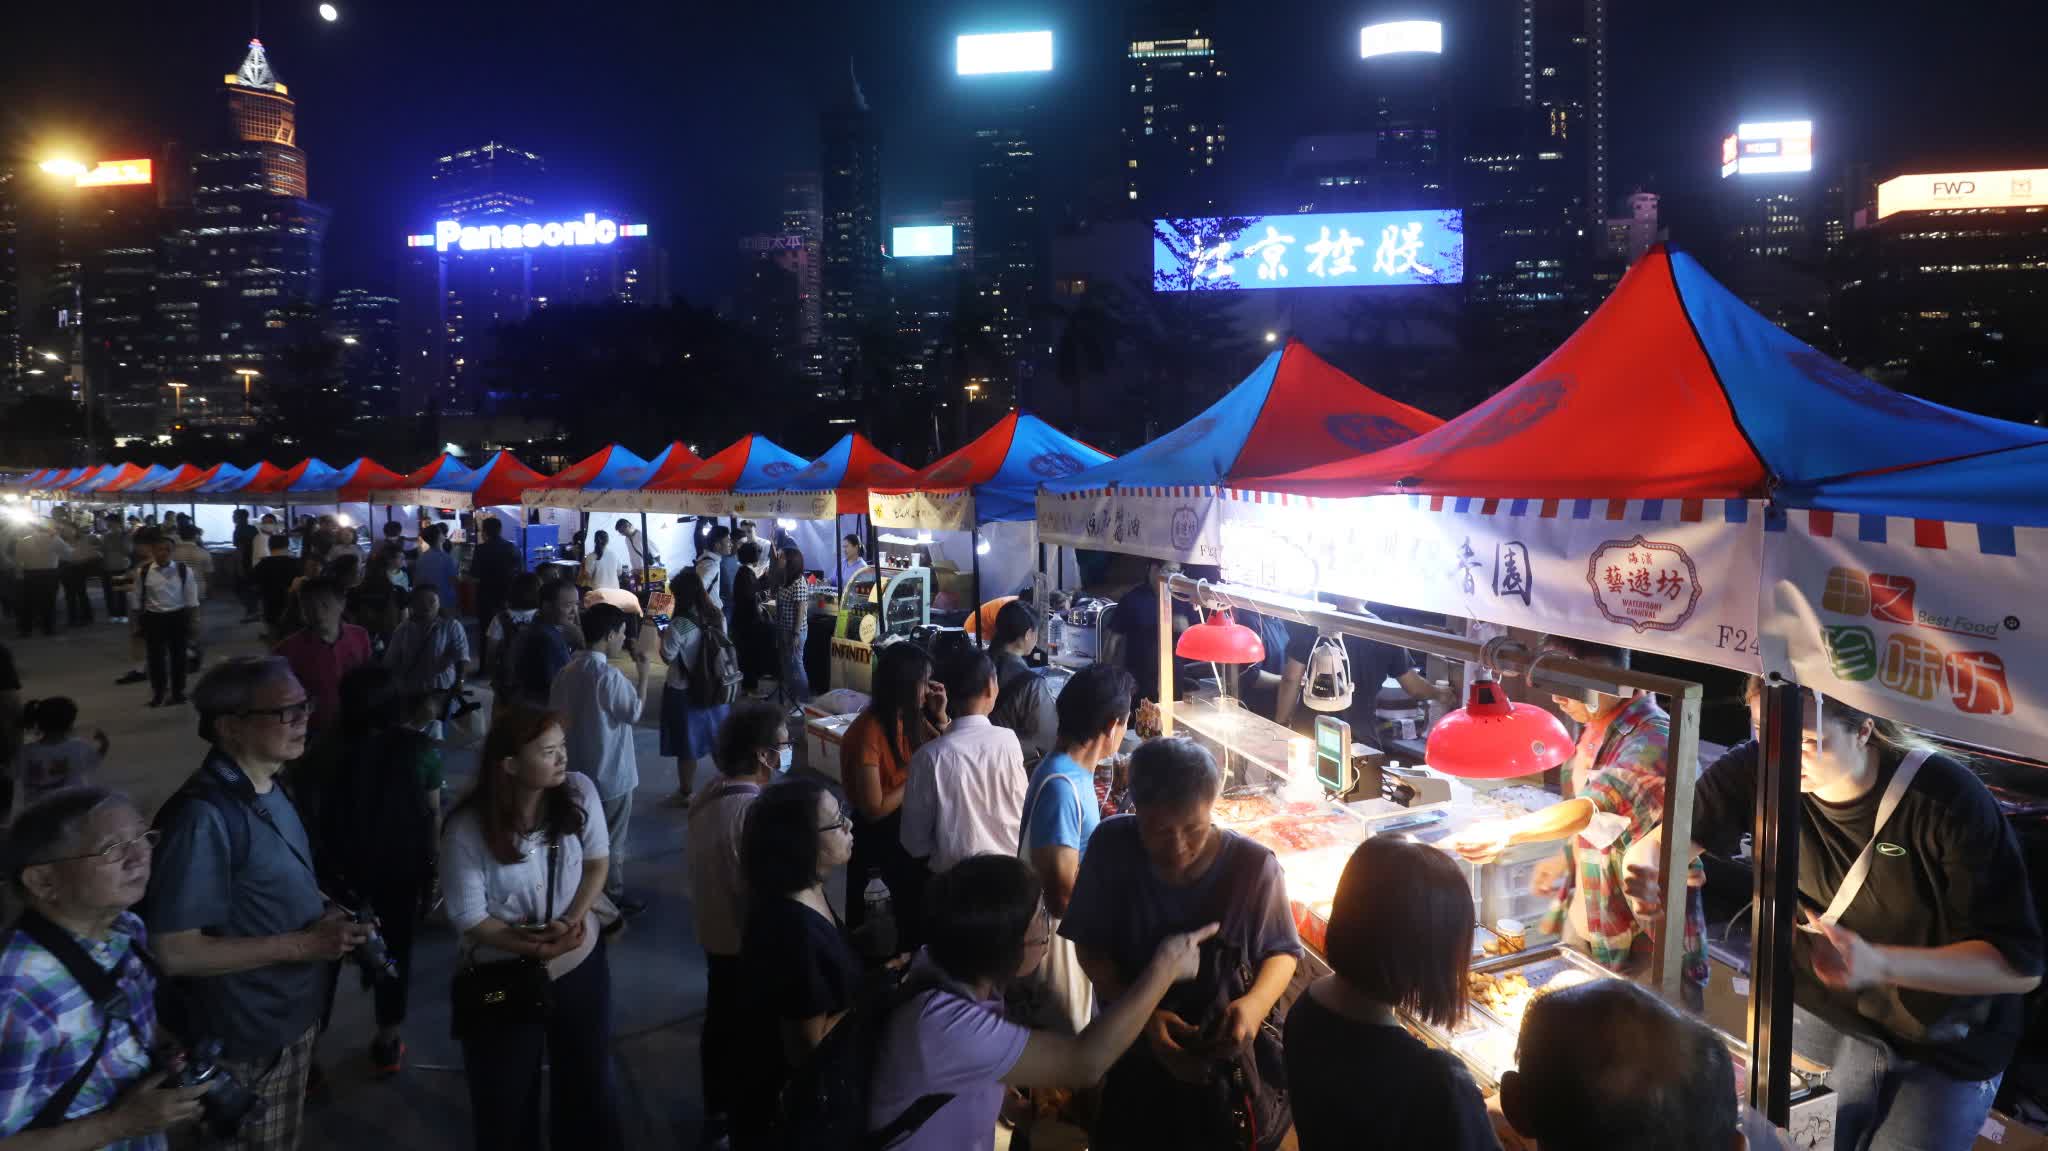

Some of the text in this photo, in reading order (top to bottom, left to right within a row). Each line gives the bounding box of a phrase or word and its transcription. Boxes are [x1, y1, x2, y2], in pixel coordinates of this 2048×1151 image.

[1933, 181, 1975, 195] FWD
[436, 213, 616, 251] Panasonic
[1603, 565, 1684, 600] 藝遊坊
[1622, 599, 1662, 612] WATERFRONT
[1626, 607, 1656, 619] CARNIVAL
[1919, 610, 2000, 635] Best Food
[832, 642, 872, 664] INFINITY
[1825, 626, 2008, 714] 珍味坊
